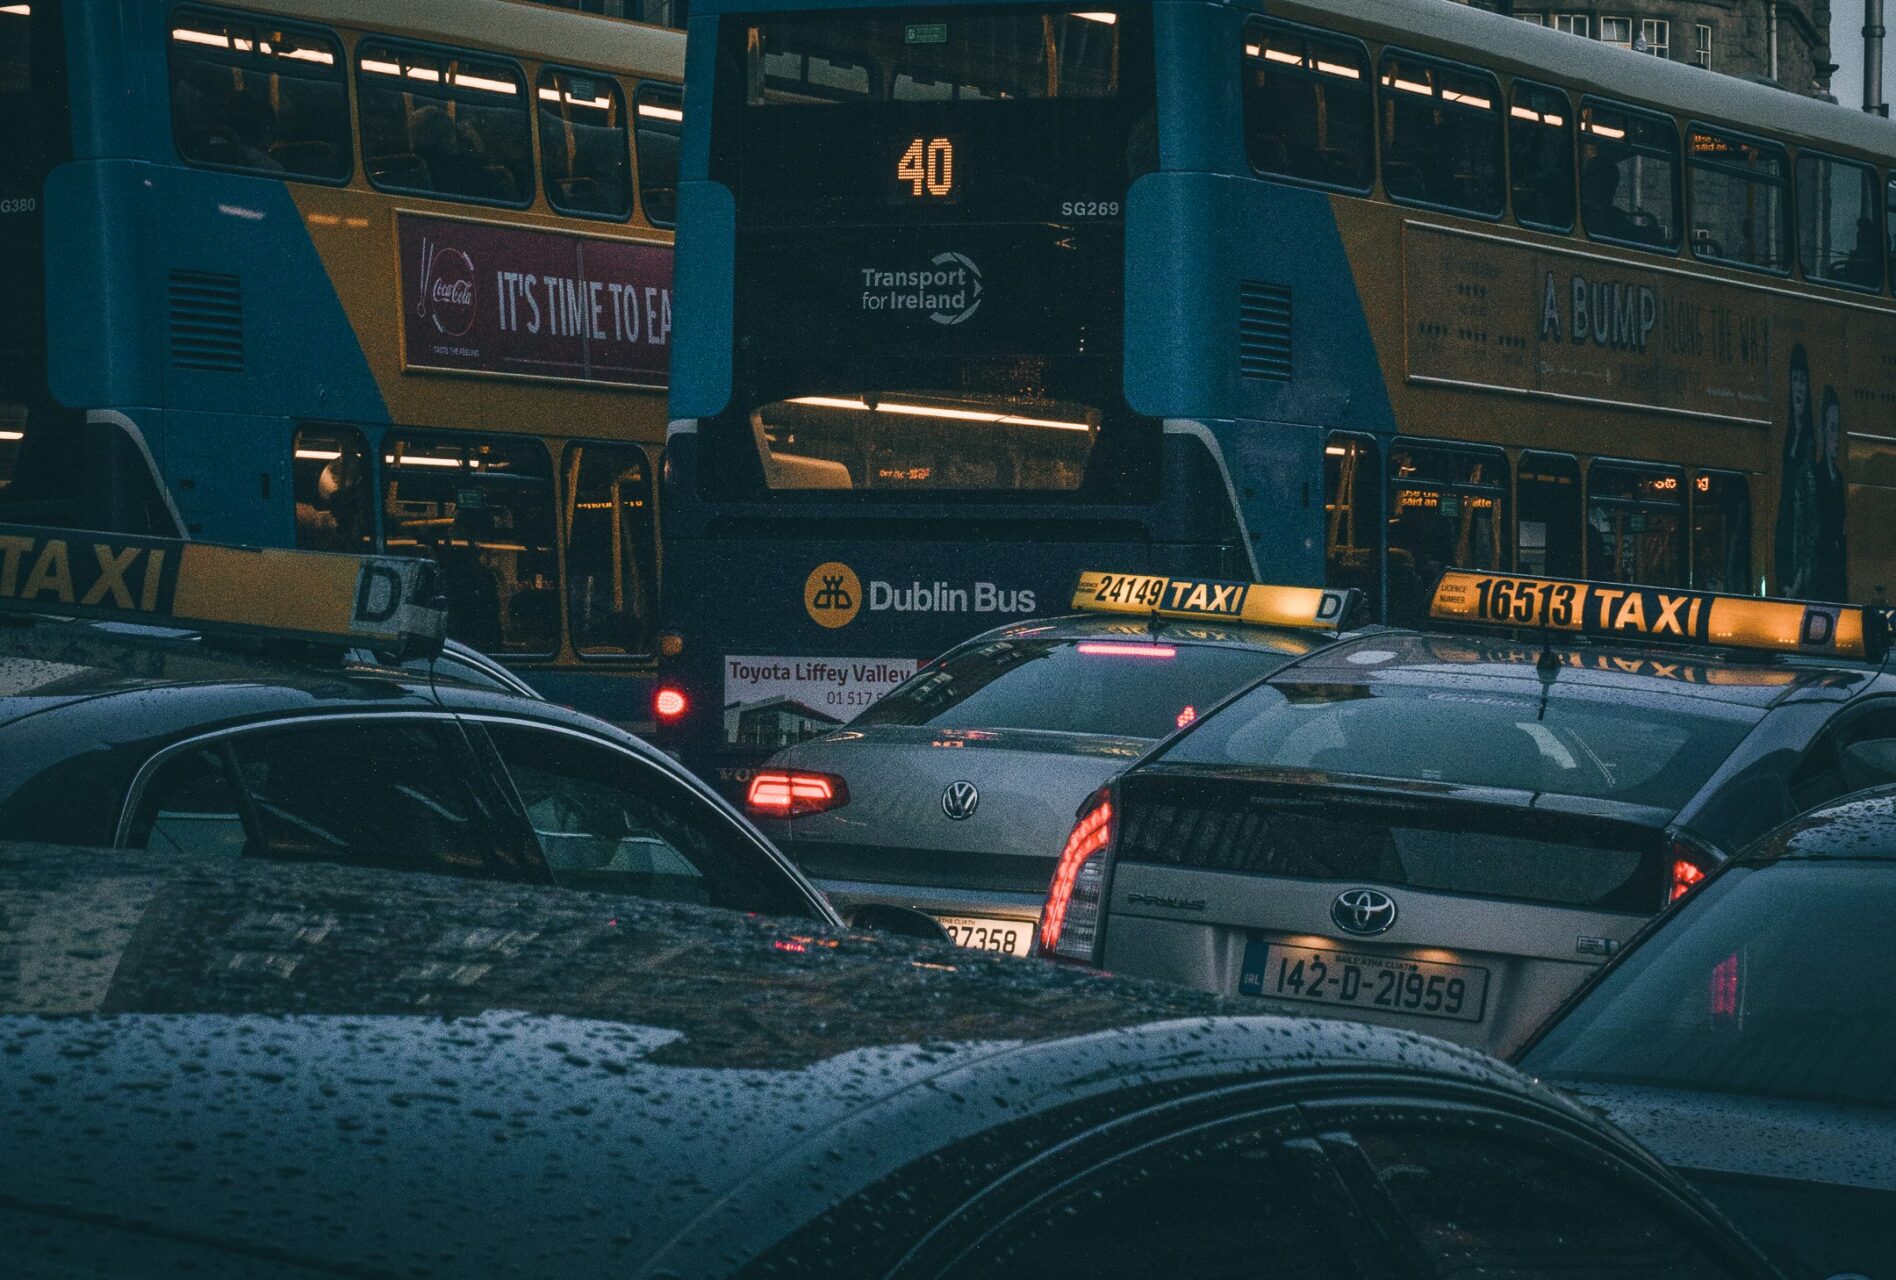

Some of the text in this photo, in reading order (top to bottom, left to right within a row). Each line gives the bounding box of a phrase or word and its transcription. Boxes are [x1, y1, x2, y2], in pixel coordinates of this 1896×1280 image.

[897, 138, 953, 196] 40
[1061, 201, 1120, 216] SG269
[862, 267, 967, 290] Transport
[862, 290, 966, 310] for Ireland
[497, 270, 541, 334] IT'S
[543, 276, 607, 341] TIME
[608, 282, 640, 344] TO
[1541, 271, 1563, 344] A
[1574, 276, 1656, 353] BUMP
[0, 538, 167, 613] TAXI
[356, 564, 401, 623] D
[869, 581, 1036, 613] Dublin Bus
[1095, 575, 1342, 621] 24149 TAXI D
[1475, 578, 1579, 627] 16513
[1594, 588, 1702, 639] TAXI
[1802, 610, 1834, 645] D
[729, 662, 791, 684] Toyota
[795, 664, 849, 686] Liffey
[826, 692, 843, 705] 01
[847, 692, 873, 705] 517
[1276, 957, 1465, 1014] 142-D-21959
